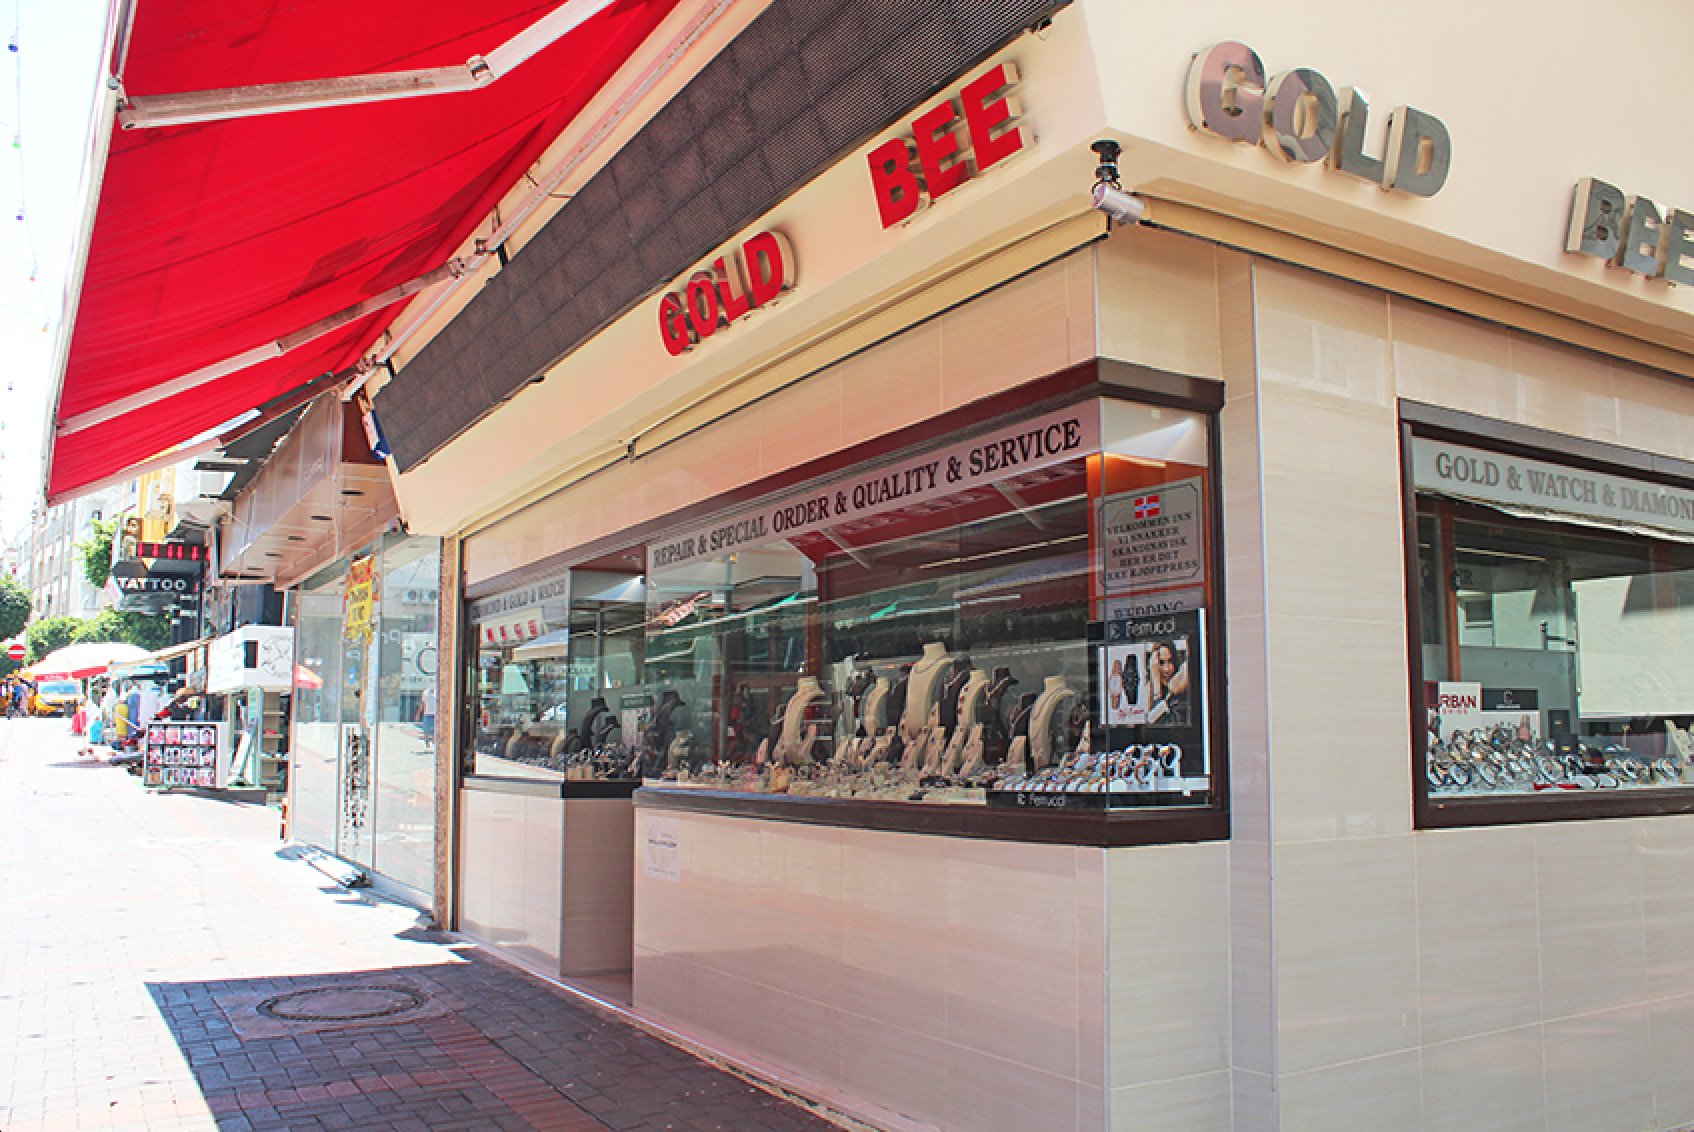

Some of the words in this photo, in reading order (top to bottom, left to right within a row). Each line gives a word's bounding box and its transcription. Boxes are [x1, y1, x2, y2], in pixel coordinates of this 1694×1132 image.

[658, 230, 797, 357] GOLD
[866, 62, 1036, 230] BEE
[1186, 40, 1452, 199] GOLD
[1564, 177, 1694, 287] BEE
[652, 537, 696, 569] REPAIR
[697, 534, 707, 555] &
[709, 515, 768, 551] SPECIAL
[772, 495, 831, 533] ORDER
[834, 491, 848, 515] &
[853, 461, 940, 509] QUALITY
[946, 455, 962, 483] &
[969, 418, 1081, 476] SERVICE
[1435, 451, 1500, 487] GOLD
[1506, 465, 1522, 492] &
[1526, 469, 1598, 505] WATCH
[1602, 483, 1617, 508] &
[117, 577, 188, 591] TATTOO
